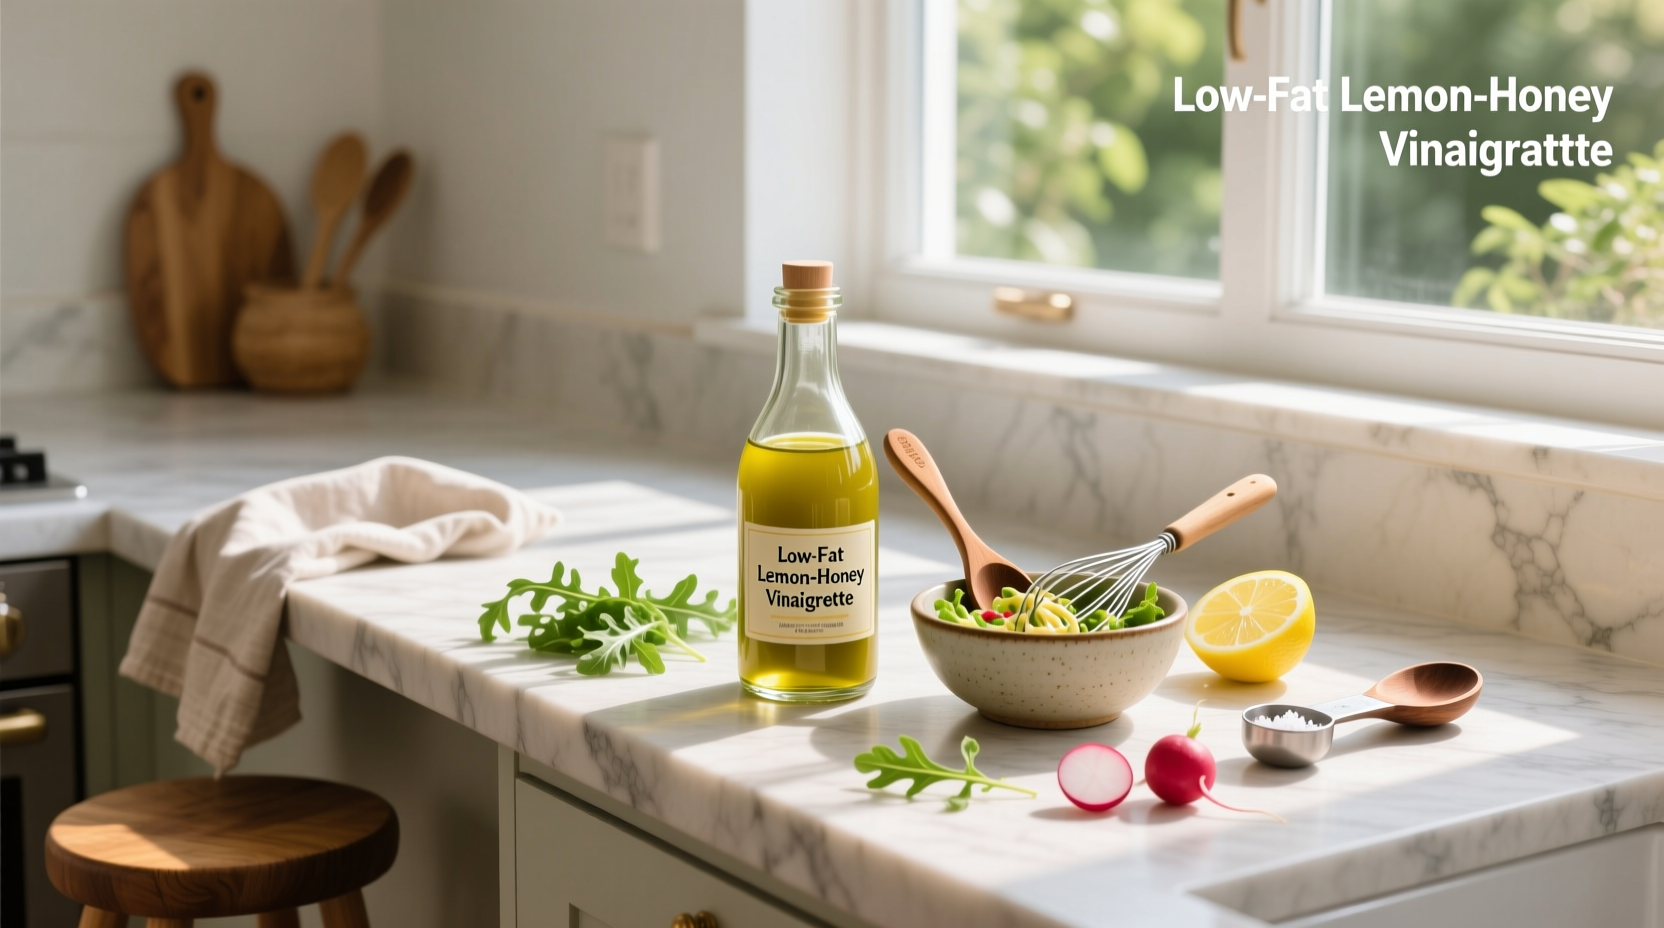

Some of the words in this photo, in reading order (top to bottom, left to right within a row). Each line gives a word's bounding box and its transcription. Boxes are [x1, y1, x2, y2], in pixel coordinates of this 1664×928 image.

[778, 546, 845, 564] Low-Fat
[757, 564, 865, 586] Lemon-Honey
[765, 588, 854, 613] Vinaigrette
